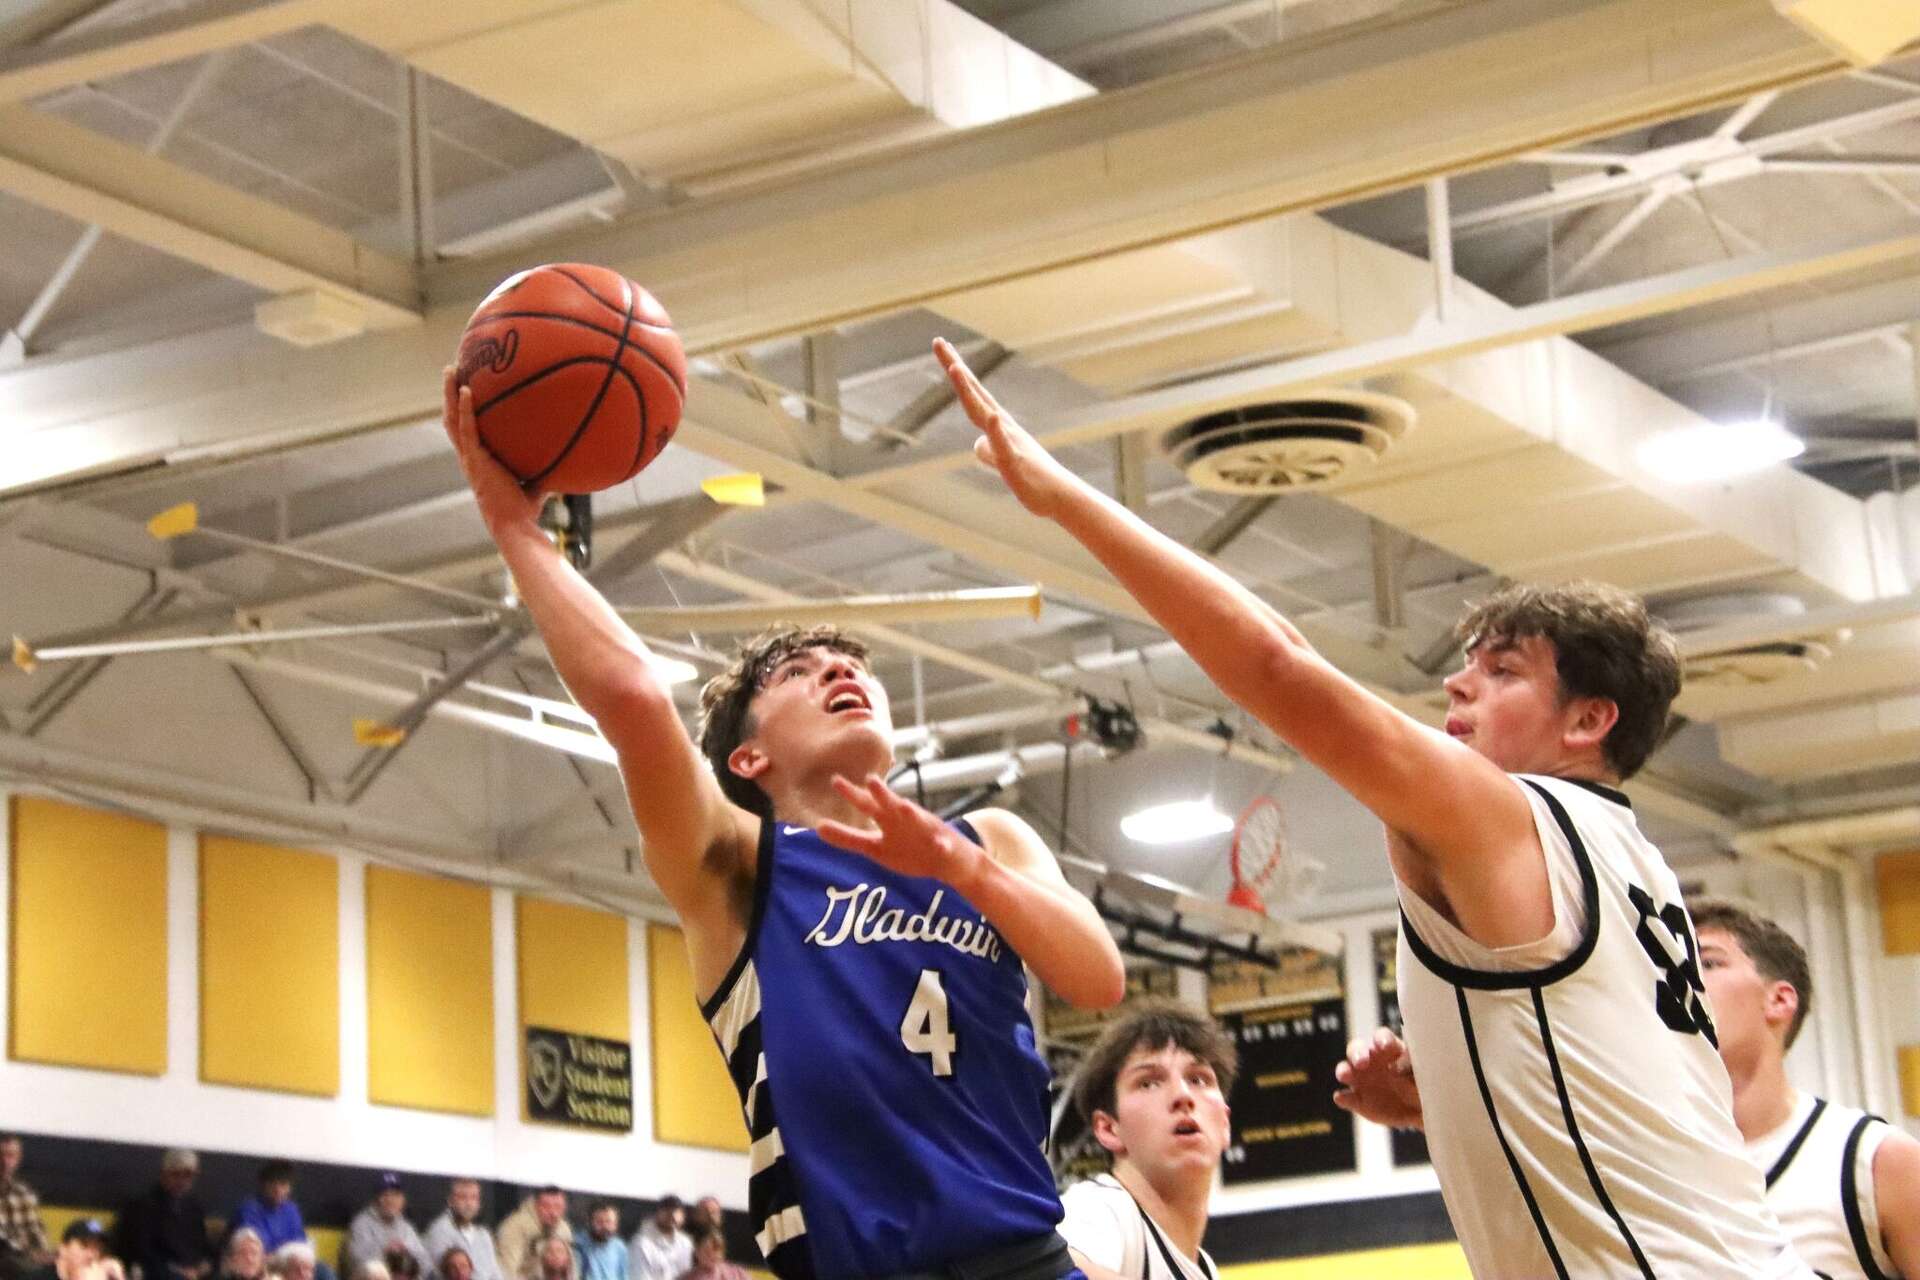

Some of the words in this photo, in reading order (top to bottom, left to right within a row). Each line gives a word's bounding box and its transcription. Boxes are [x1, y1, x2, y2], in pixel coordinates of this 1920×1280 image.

[901, 969, 956, 1076] 4
[567, 1037, 627, 1070] Visitor
[564, 1062, 630, 1099] Student
[567, 1095, 631, 1129] Section
